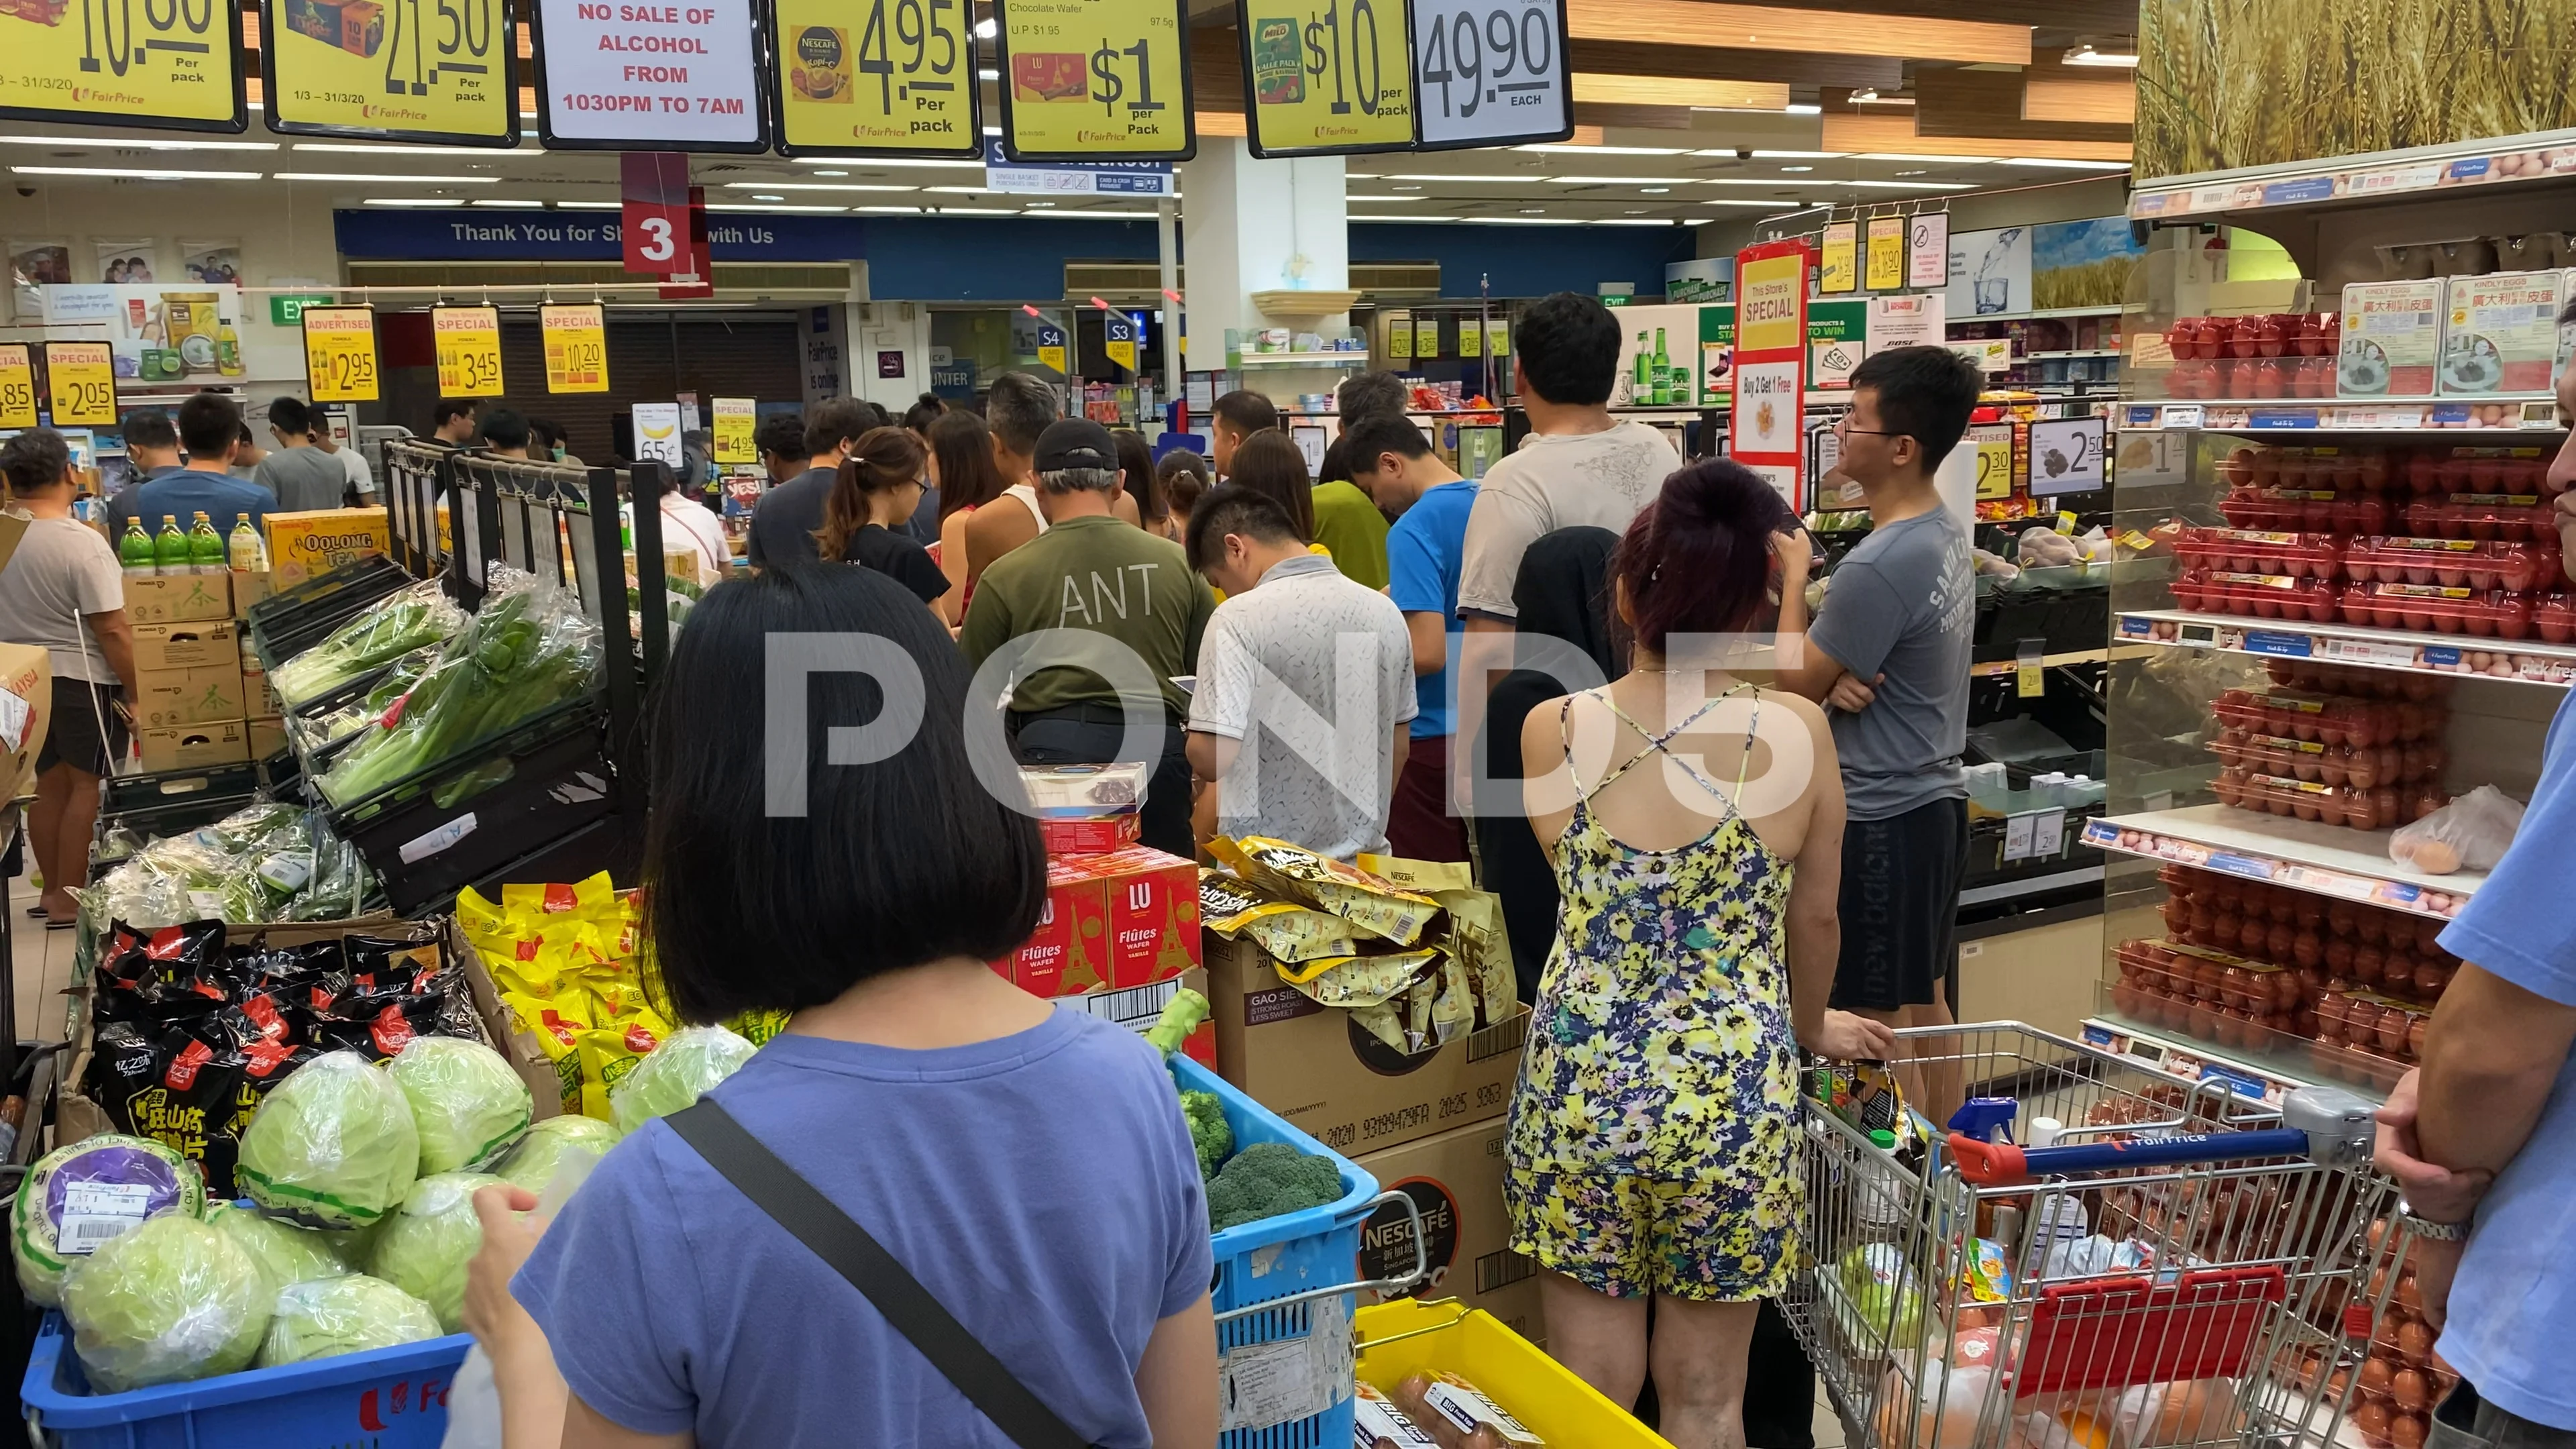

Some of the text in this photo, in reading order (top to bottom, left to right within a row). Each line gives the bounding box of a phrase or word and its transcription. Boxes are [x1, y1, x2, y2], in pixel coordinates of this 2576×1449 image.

[578, 3, 714, 25] NO SALE OF
[1010, 3, 1082, 13] Chocolate Wafer
[1265, 28, 1287, 39] MILO
[598, 35, 708, 54] ALCOHOL
[176, 58, 199, 68] Per
[1423, 7, 1551, 118] 49.90
[171, 72, 205, 83] pack
[623, 65, 688, 83] FROM
[1091, 38, 1165, 117] $1
[22, 75, 72, 91] 31/3/20
[460, 78, 480, 88] Per
[92, 91, 144, 105] FairPrice
[325, 92, 364, 104] 31/3/20
[455, 92, 486, 102] pack
[1381, 89, 1402, 101] per
[1511, 95, 1542, 106] EACH
[563, 94, 744, 115] 1030PM TO 7AM
[916, 97, 945, 111] Per
[1377, 104, 1408, 118] pack
[380, 107, 427, 120] FairPrice
[1132, 109, 1153, 121] per
[867, 127, 906, 137] FairPrice
[910, 119, 953, 134] pack
[1128, 124, 1159, 135] Pack
[1090, 131, 1126, 142] FairPrice
[2236, 184, 2262, 201] fresh
[451, 223, 515, 241] Thank
[521, 225, 560, 241] You
[567, 225, 596, 241] for
[749, 228, 774, 244] Us
[1825, 231, 1854, 240] SPECIAL
[1870, 227, 1901, 236] SPECIAL
[639, 217, 674, 261] 3
[1949, 252, 1966, 260] Quality
[1752, 283, 1788, 297] This Store's
[1746, 298, 1793, 322] SPECIAL
[308, 320, 370, 329] ADVERTISED
[437, 320, 494, 329] SPECIAL
[545, 317, 600, 327] SPECIAL
[1043, 331, 1060, 345] S4
[1112, 325, 1128, 339] S3
[1808, 327, 1844, 335] TO WIN
[808, 341, 837, 362] FairPrice
[1112, 343, 1128, 352] CARD
[1112, 350, 1128, 359] ONLY
[51, 355, 107, 363] SPECIAL
[810, 371, 816, 389] is
[1744, 376, 1791, 398] Buy 2 Get 1 Free
[2223, 410, 2249, 423] fresh
[727, 480, 761, 498] YES!
[305, 534, 372, 551] OOLONG
[325, 551, 358, 568] TEA
[1059, 563, 1159, 629] ANT
[2520, 661, 2548, 678] pick
[2159, 843, 2208, 861] pick fresh
[1129, 882, 1151, 910] LU
[1119, 928, 1157, 944] Flûtes
[1126, 941, 1150, 951] WAFER
[1022, 945, 1061, 962] Flûtes
[1128, 950, 1149, 959] VANILLE
[1030, 958, 1054, 968] WAFER
[1031, 968, 1053, 977] VANILLE
[1251, 993, 1277, 1006] GAO
[1251, 1000, 1303, 1016] STRONG ROAST
[1252, 1008, 1293, 1022] LESS SWEET
[1327, 1123, 1355, 1148] 2020
[1477, 1083, 1501, 1108] 9363
[1366, 1200, 1448, 1250] NESCAFÉ
[1474, 1393, 1506, 1417] BIG
[1377, 1403, 1411, 1426] BIG
[1443, 1399, 1474, 1428] BIG Fresh Eggs
